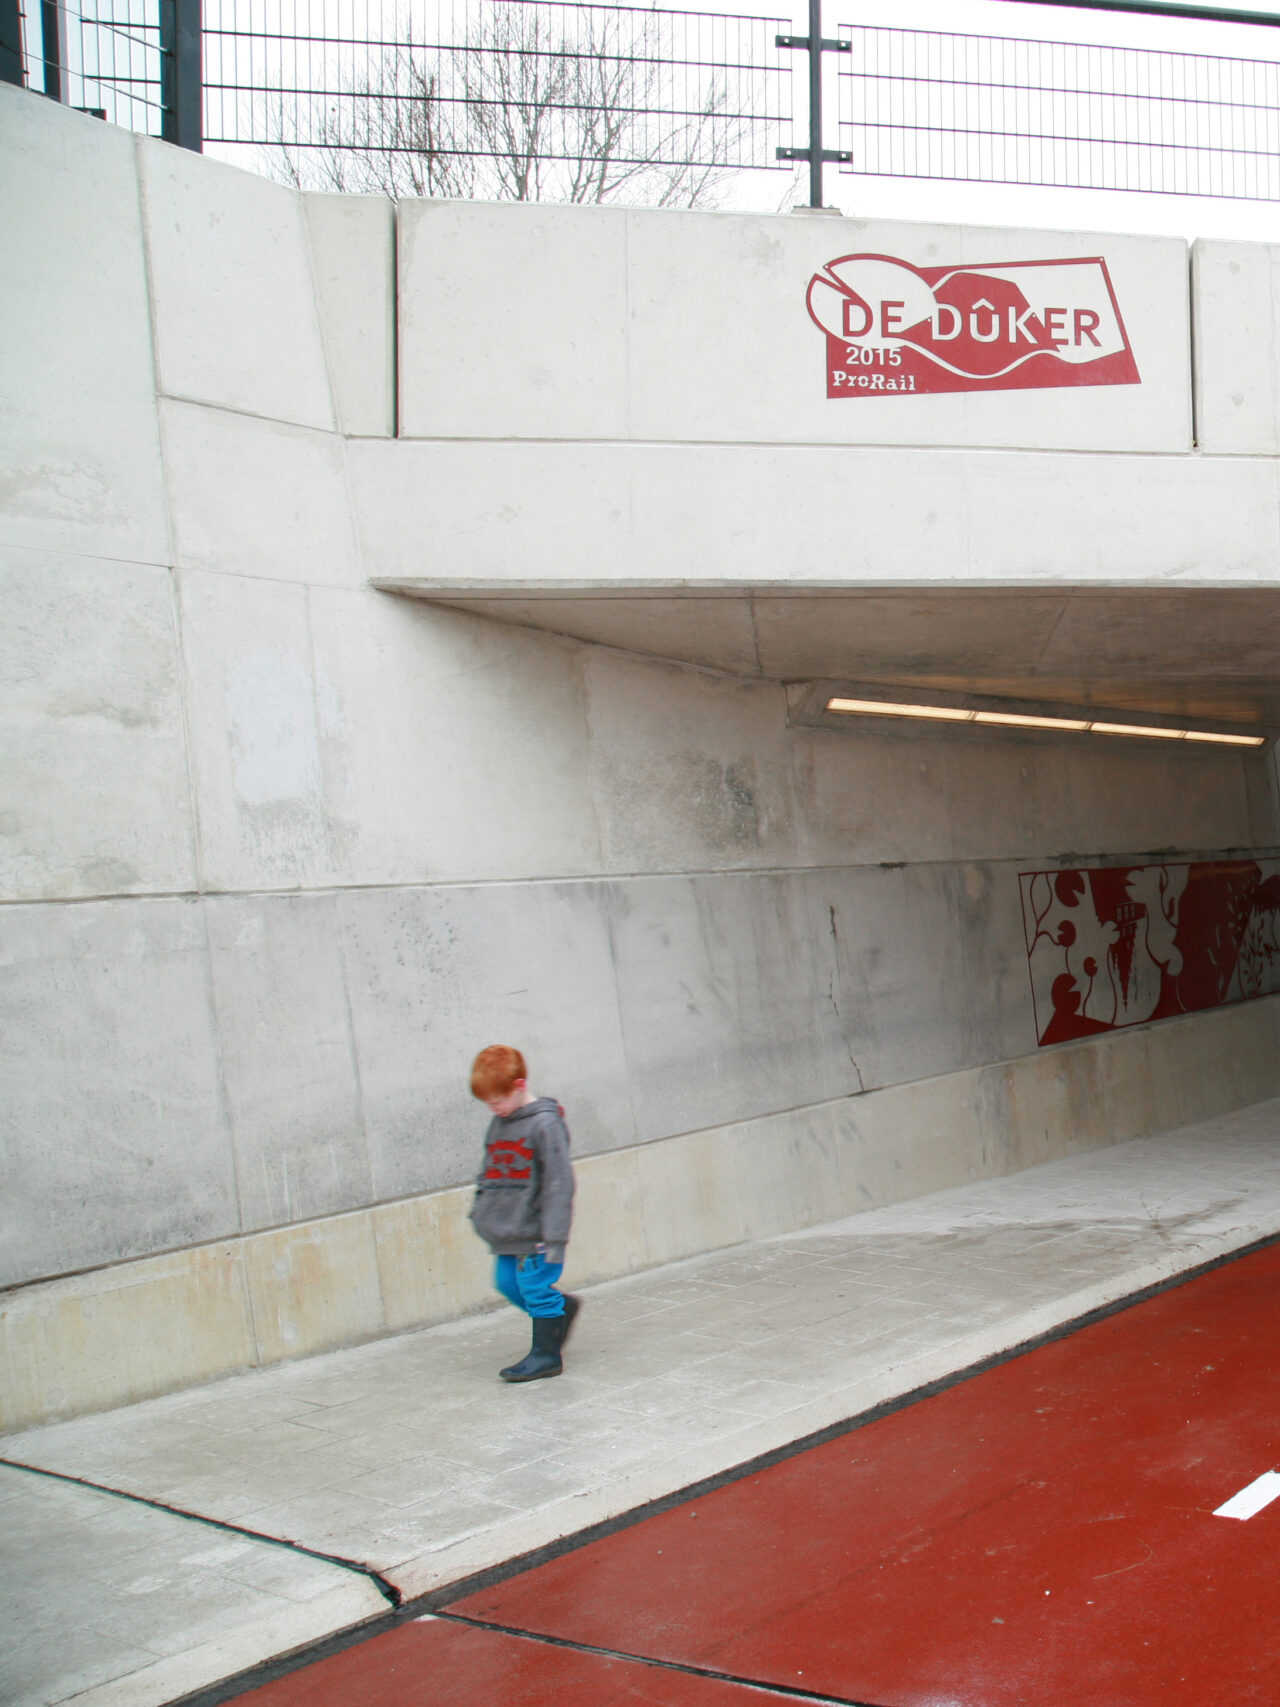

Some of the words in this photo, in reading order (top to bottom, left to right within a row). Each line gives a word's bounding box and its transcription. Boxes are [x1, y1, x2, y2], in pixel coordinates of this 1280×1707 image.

[842, 298, 905, 339] DE
[932, 294, 1102, 348] DÛKER
[846, 347, 901, 366] 2015
[832, 370, 916, 391] ProRail
